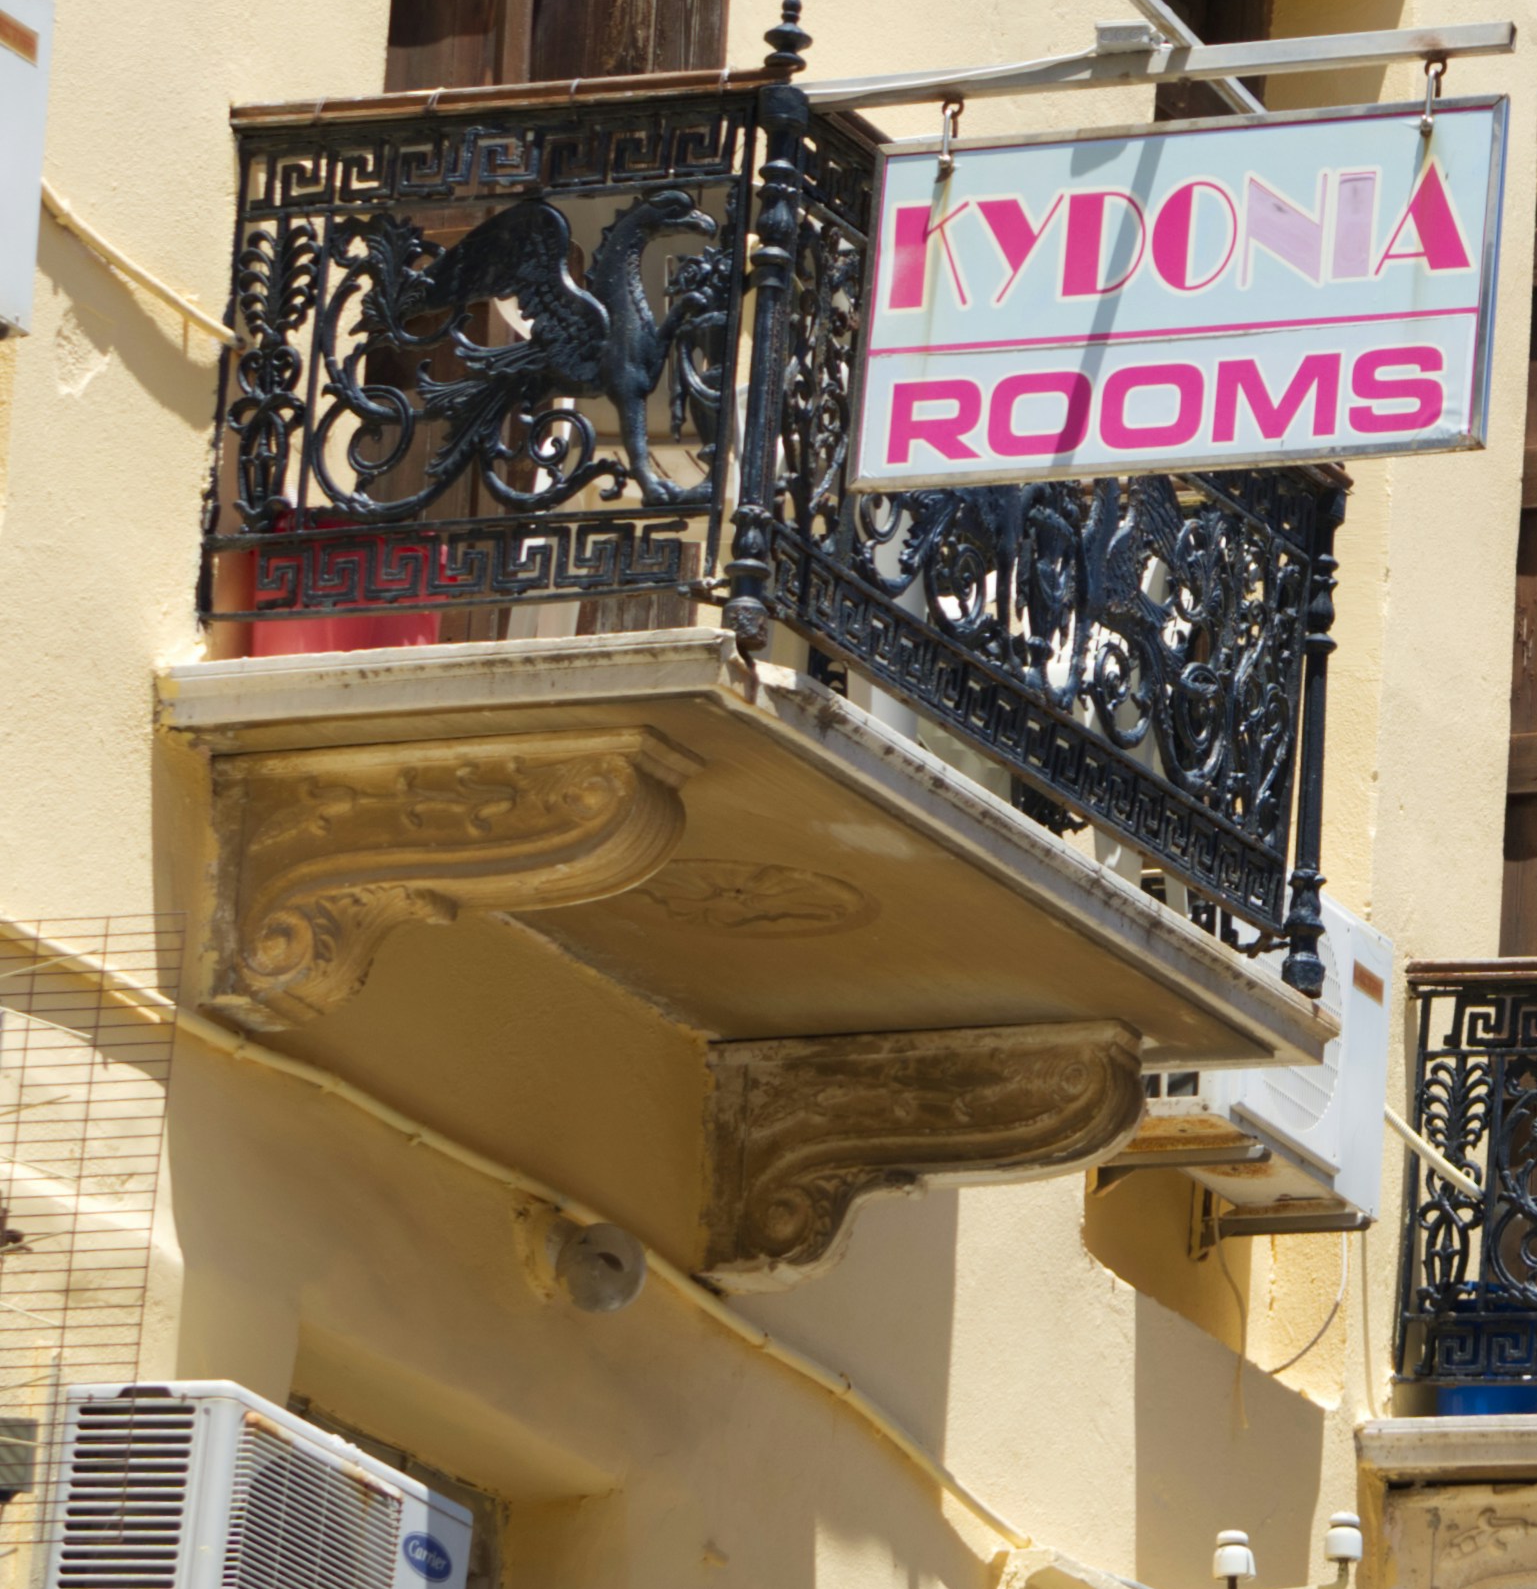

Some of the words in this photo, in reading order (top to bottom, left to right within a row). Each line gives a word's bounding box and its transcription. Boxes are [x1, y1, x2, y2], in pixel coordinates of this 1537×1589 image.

[888, 159, 1472, 309] KYDONIA
[886, 345, 1444, 465] ROOMS
[408, 1539, 447, 1570] Carrier
